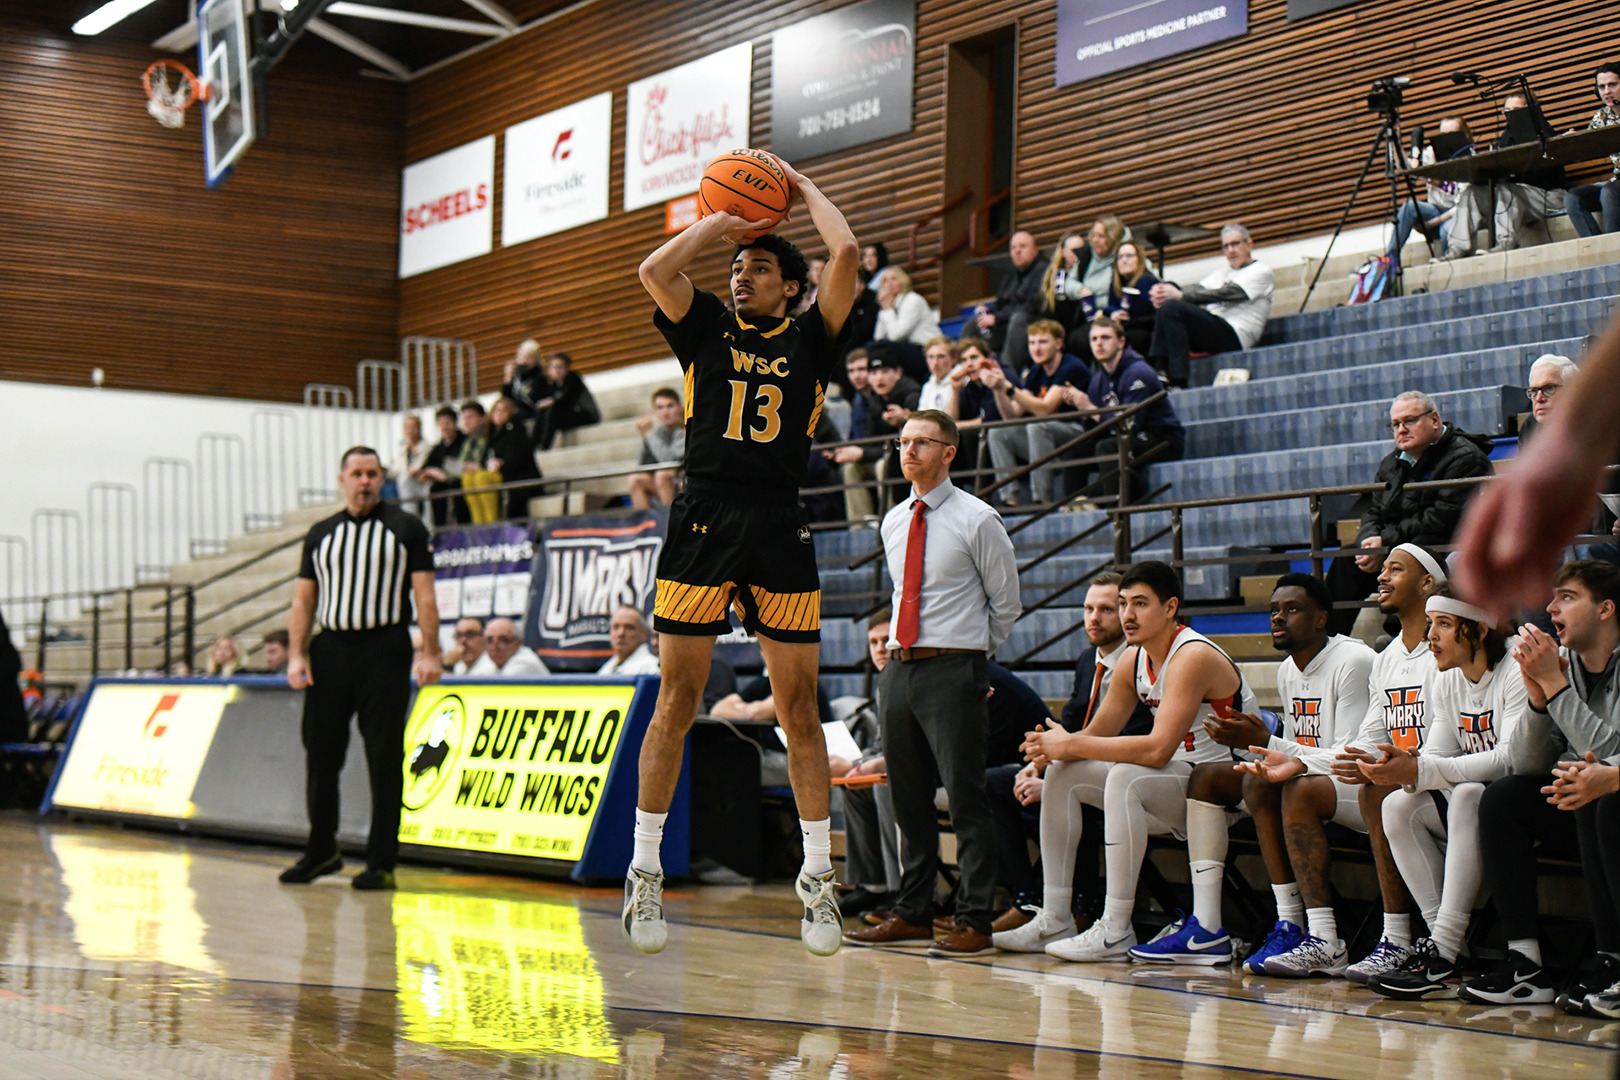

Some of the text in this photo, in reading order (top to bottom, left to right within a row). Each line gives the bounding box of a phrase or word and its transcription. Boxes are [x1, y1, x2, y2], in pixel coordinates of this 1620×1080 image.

[1077, 6, 1227, 61] OFFICIAL SPORTS MEDICINE PARTNER
[732, 149, 785, 182] Wilson
[732, 169, 769, 191] EVO
[523, 171, 585, 204] Fireside
[403, 183, 488, 234] SCHEELS
[730, 346, 790, 378] WSC
[722, 379, 784, 443] 13
[1385, 702, 1424, 731] MARY
[470, 709, 620, 764] BUFFALO
[455, 770, 600, 816] WILD WINGS
